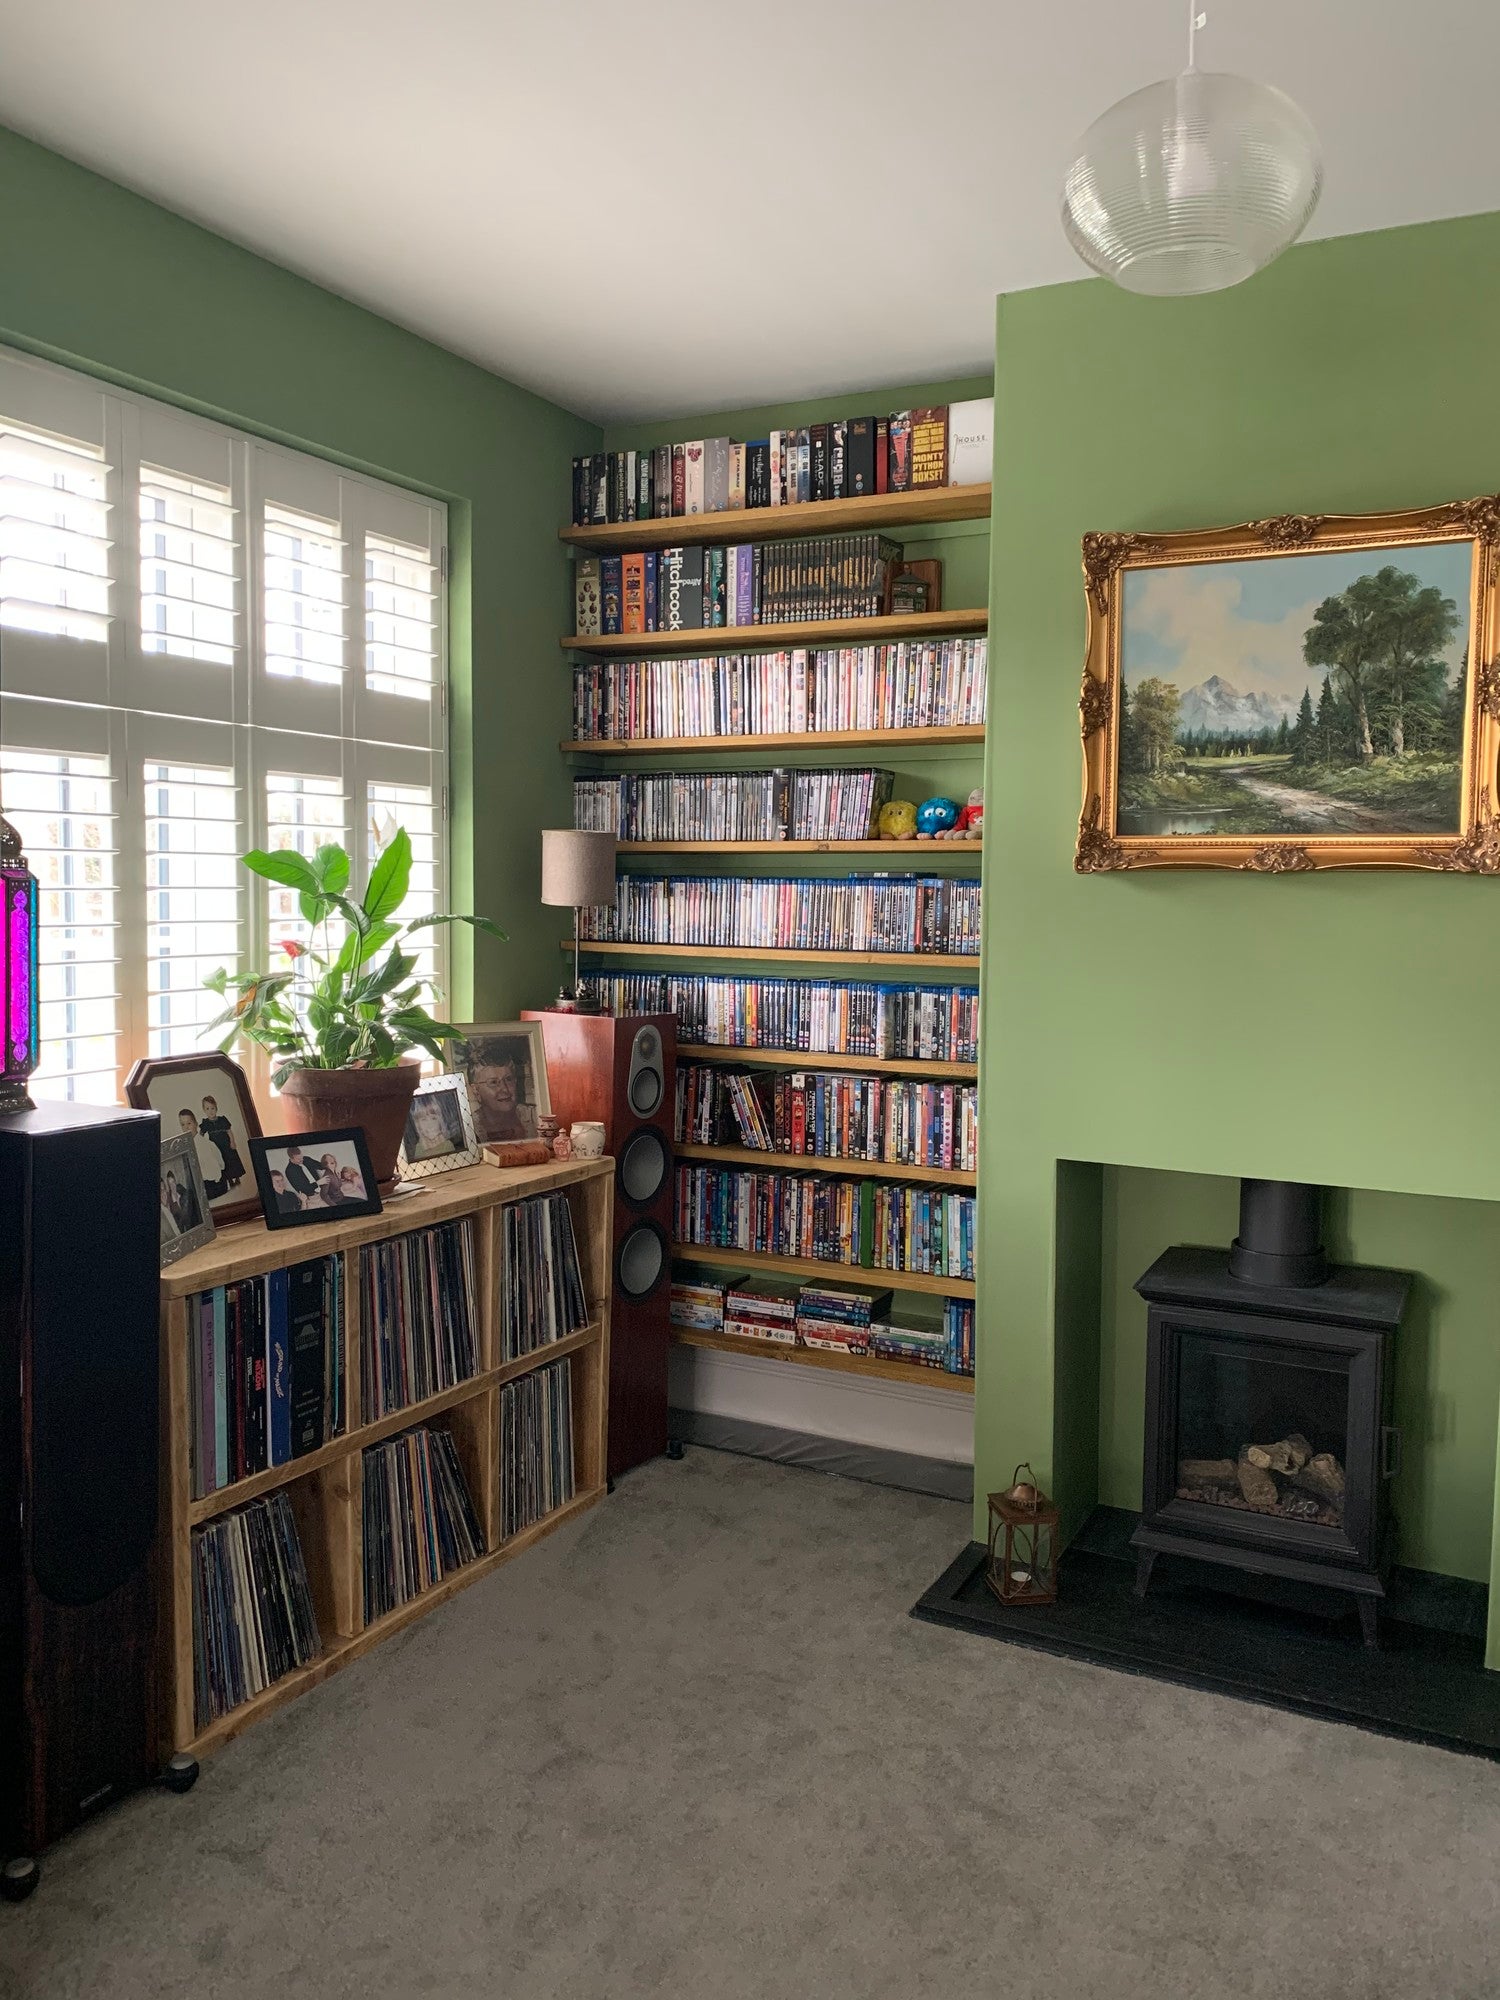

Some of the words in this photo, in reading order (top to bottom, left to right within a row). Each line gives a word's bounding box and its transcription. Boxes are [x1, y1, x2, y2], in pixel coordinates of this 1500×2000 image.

[958, 434, 986, 443] HOUSE
[912, 452, 944, 464] MONTY
[912, 460, 944, 473] PYTHON
[912, 469, 943, 484] BOXSET
[669, 548, 683, 631] Hitchcock
[682, 578, 702, 587] Alfred
[275, 1348, 283, 1373] SOUND
[254, 1359, 262, 1391] NIXON
[274, 1377, 285, 1398] MUSIC
